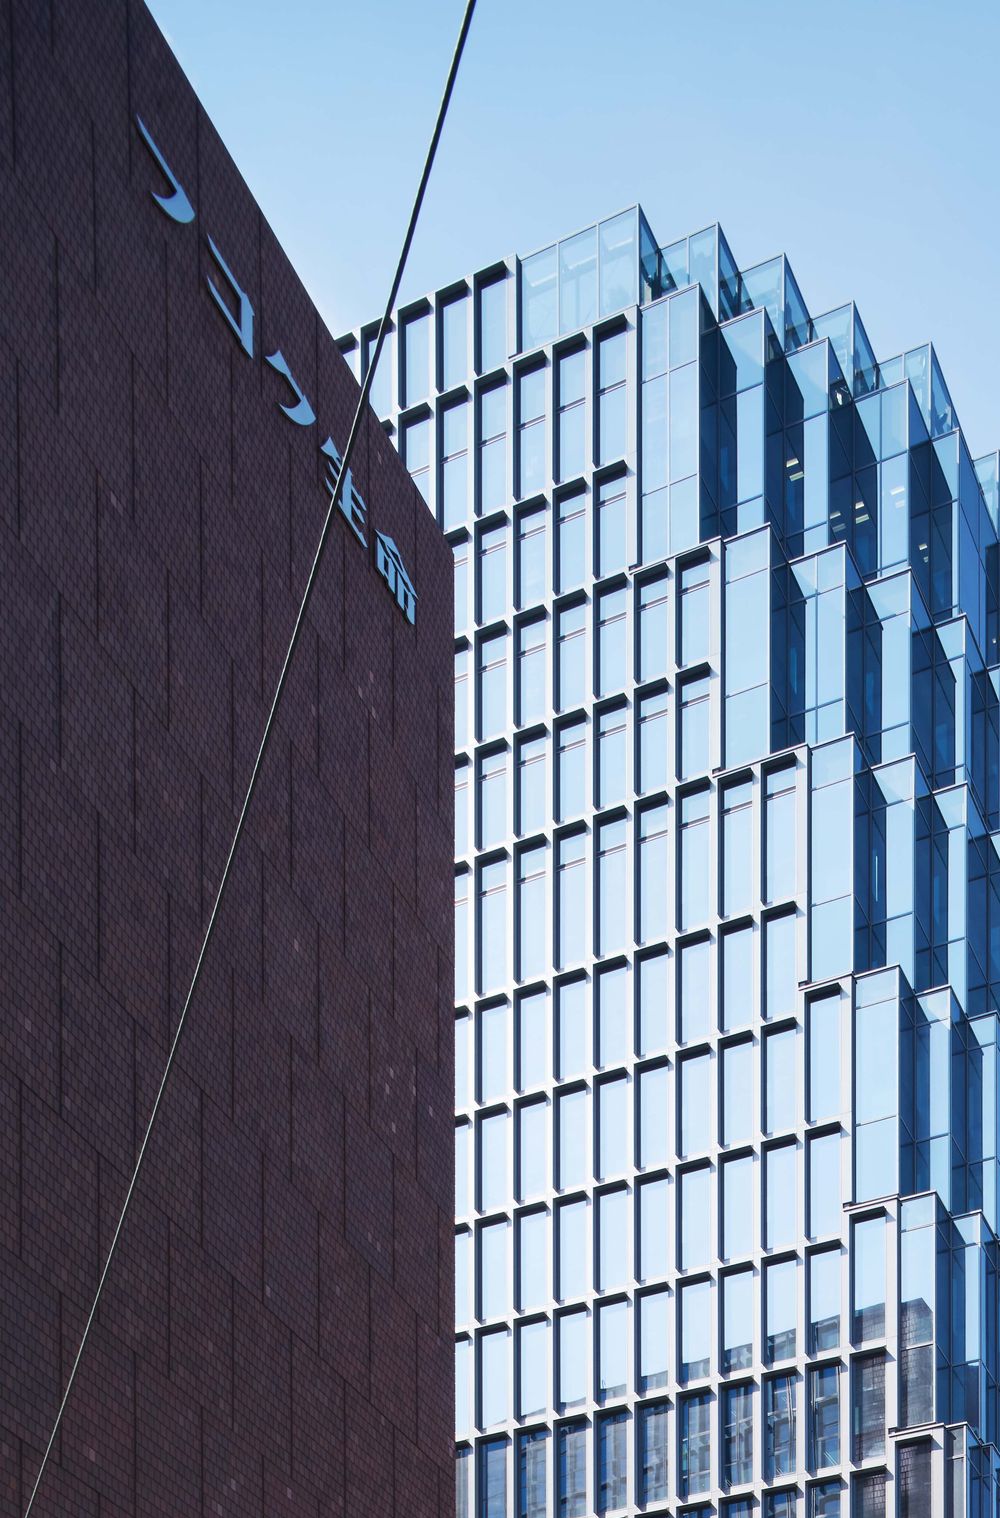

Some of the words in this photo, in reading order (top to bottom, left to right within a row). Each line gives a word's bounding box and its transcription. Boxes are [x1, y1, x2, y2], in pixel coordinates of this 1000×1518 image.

[136, 114, 418, 625] フコク生命
